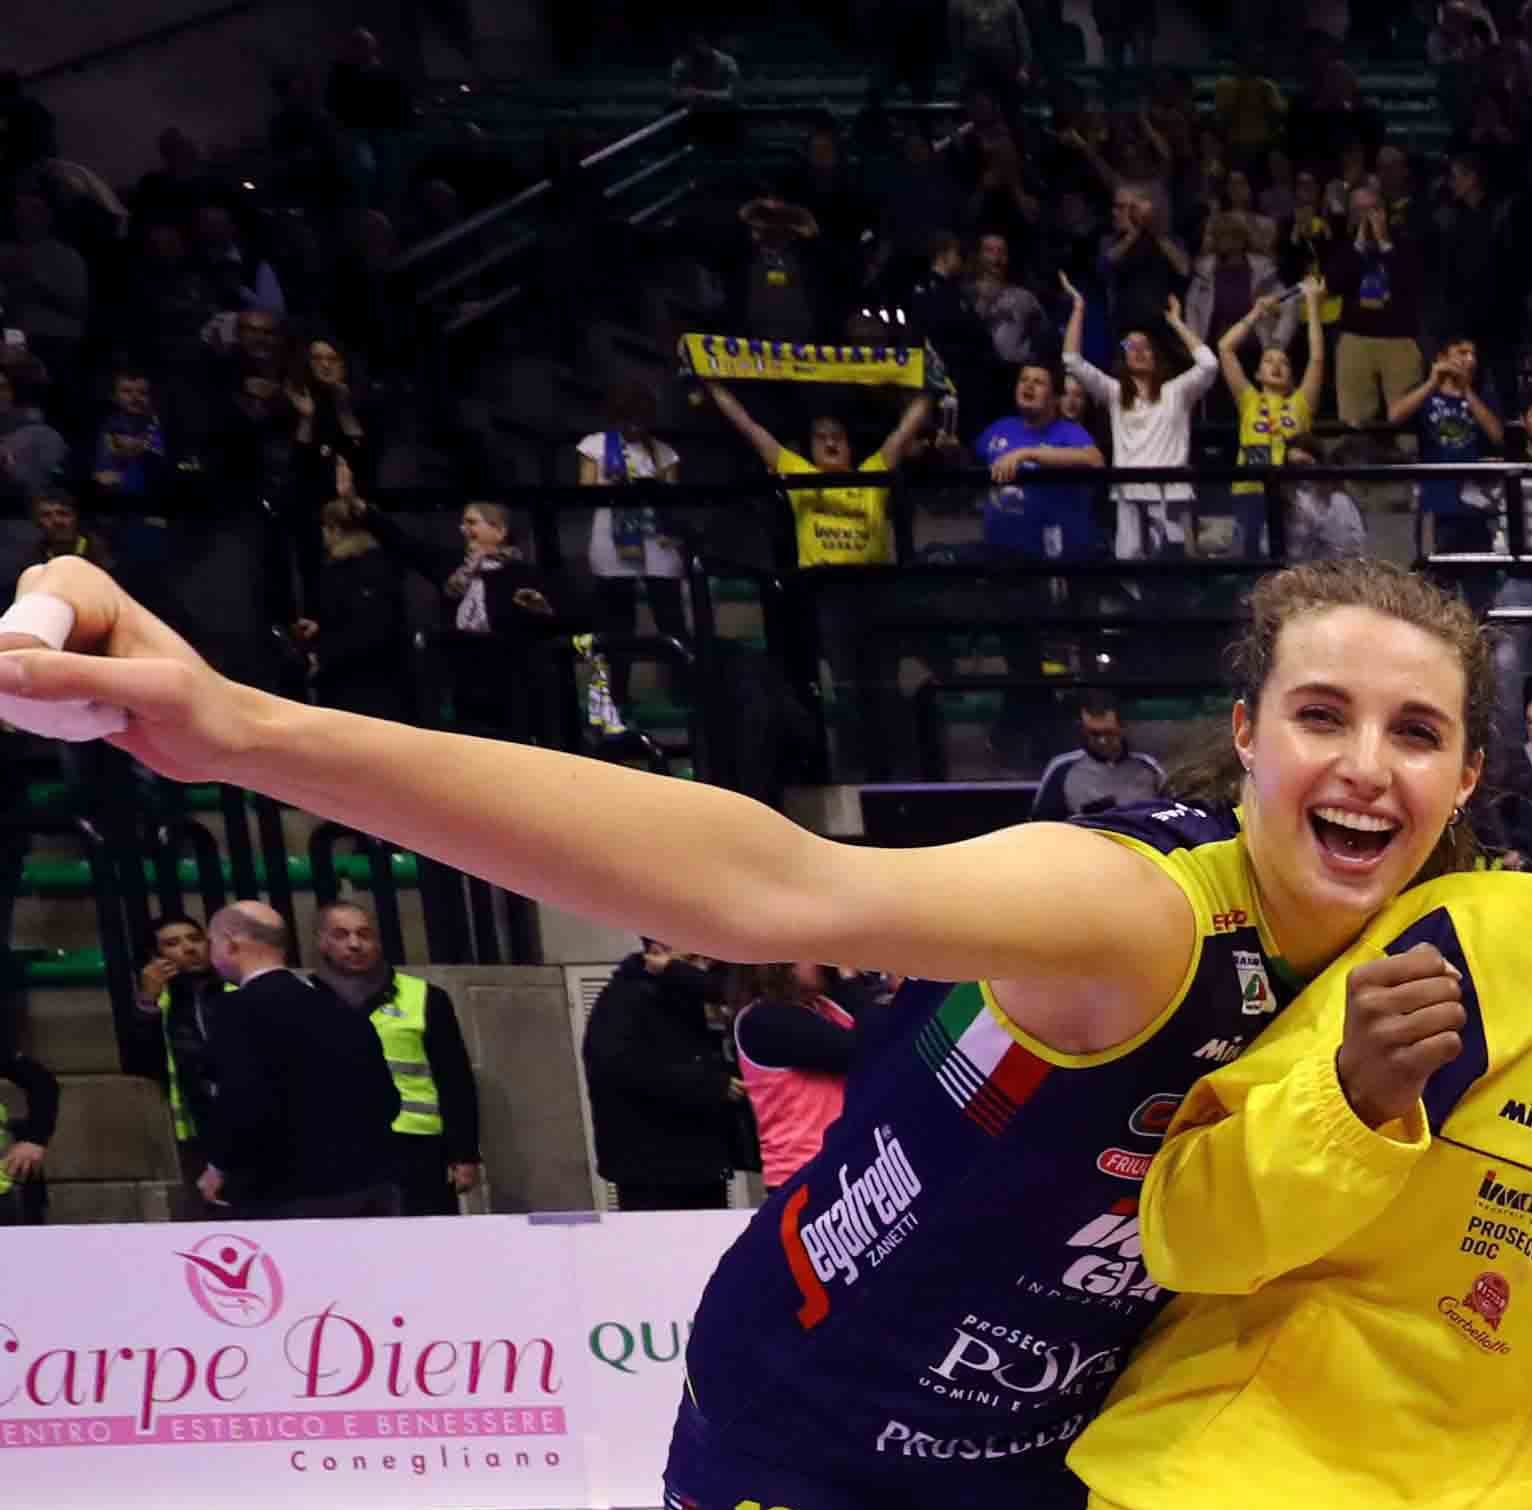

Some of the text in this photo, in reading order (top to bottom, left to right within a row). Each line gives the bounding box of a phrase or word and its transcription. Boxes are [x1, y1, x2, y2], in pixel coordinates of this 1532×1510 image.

[826, 1212, 920, 1269] ZANETTI
[1460, 1236, 1501, 1261] DOC
[283, 1302, 563, 1400] Diem
[588, 1320, 696, 1374] QU
[171, 1411, 325, 1440] ESTETICO
[343, 1412, 359, 1438] E
[376, 1408, 556, 1437] BENESSERE
[289, 1447, 562, 1475] Conegliano
